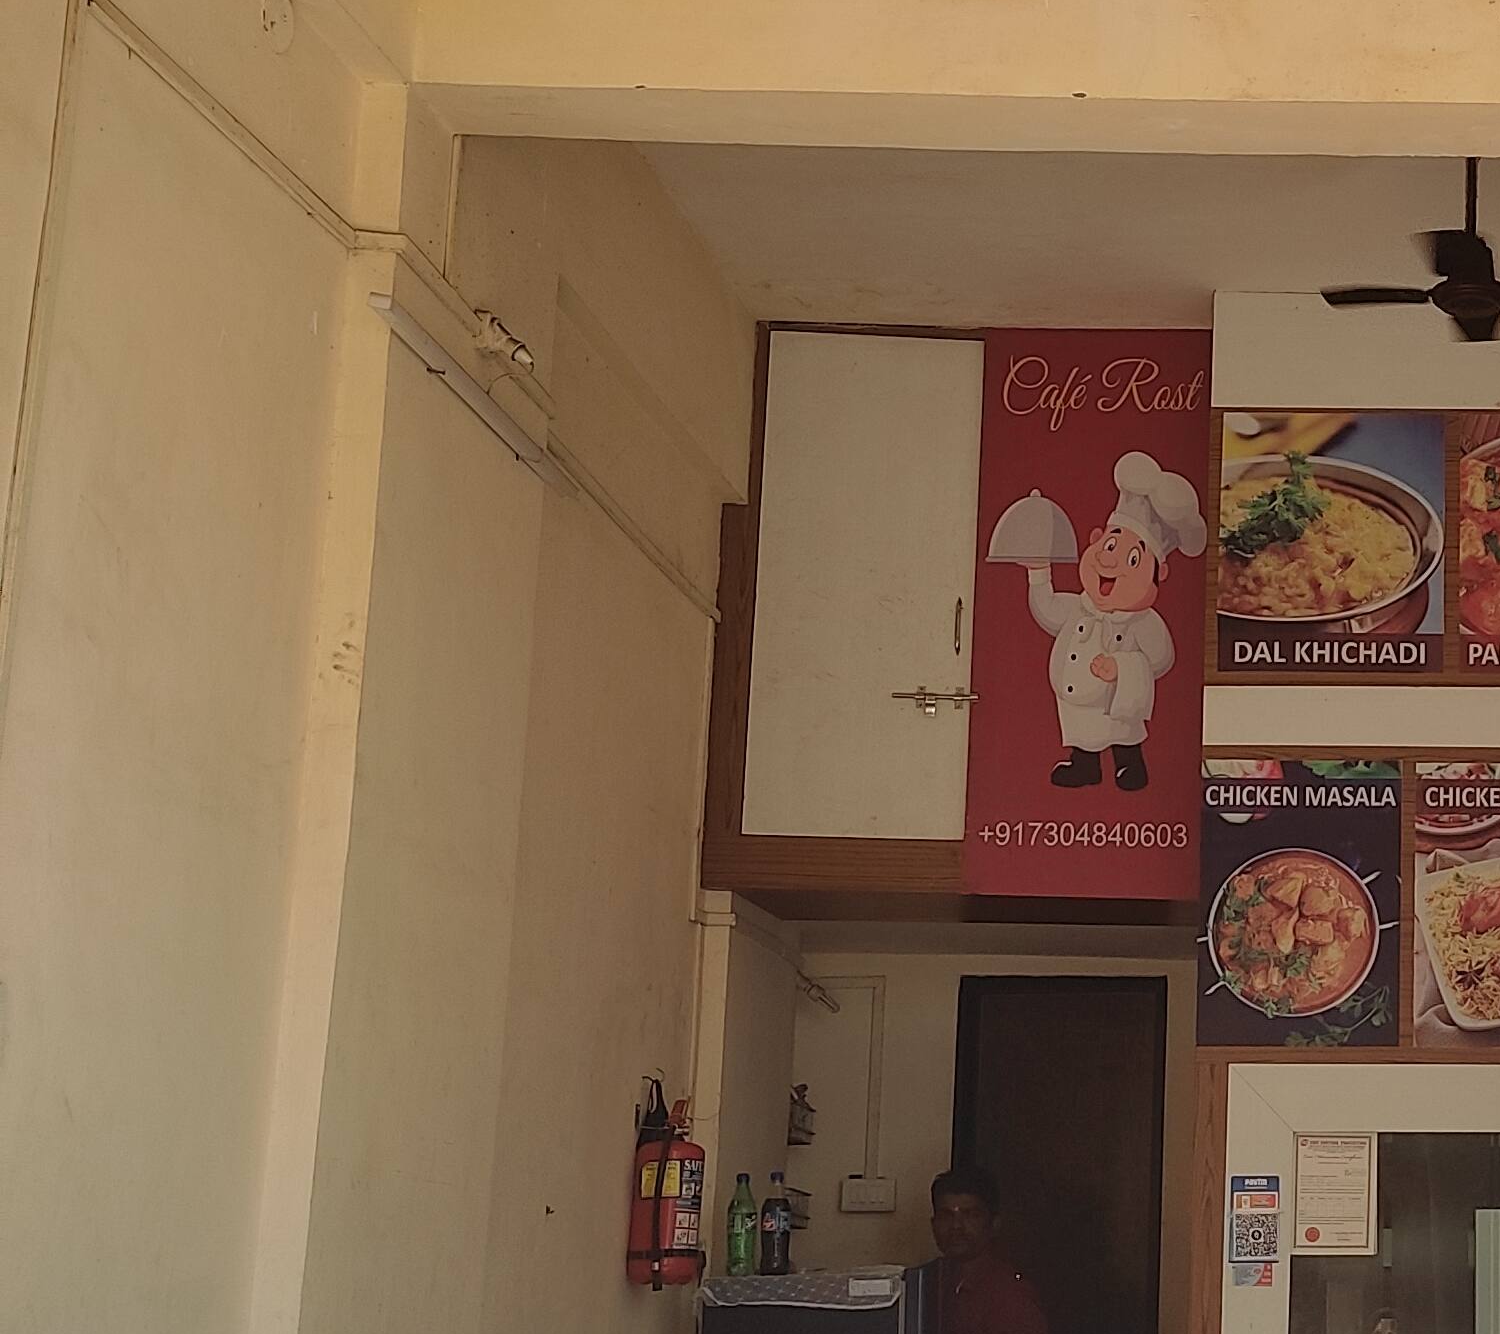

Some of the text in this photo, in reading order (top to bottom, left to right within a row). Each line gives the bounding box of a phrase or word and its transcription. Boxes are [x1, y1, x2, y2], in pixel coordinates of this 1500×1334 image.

[1002, 354, 1205, 431] Café Rost
[1233, 641, 1426, 665] DAL KHICHADI
[1205, 785, 1397, 808] CHICKEN MASALA
[978, 821, 1188, 847] +917304840603
